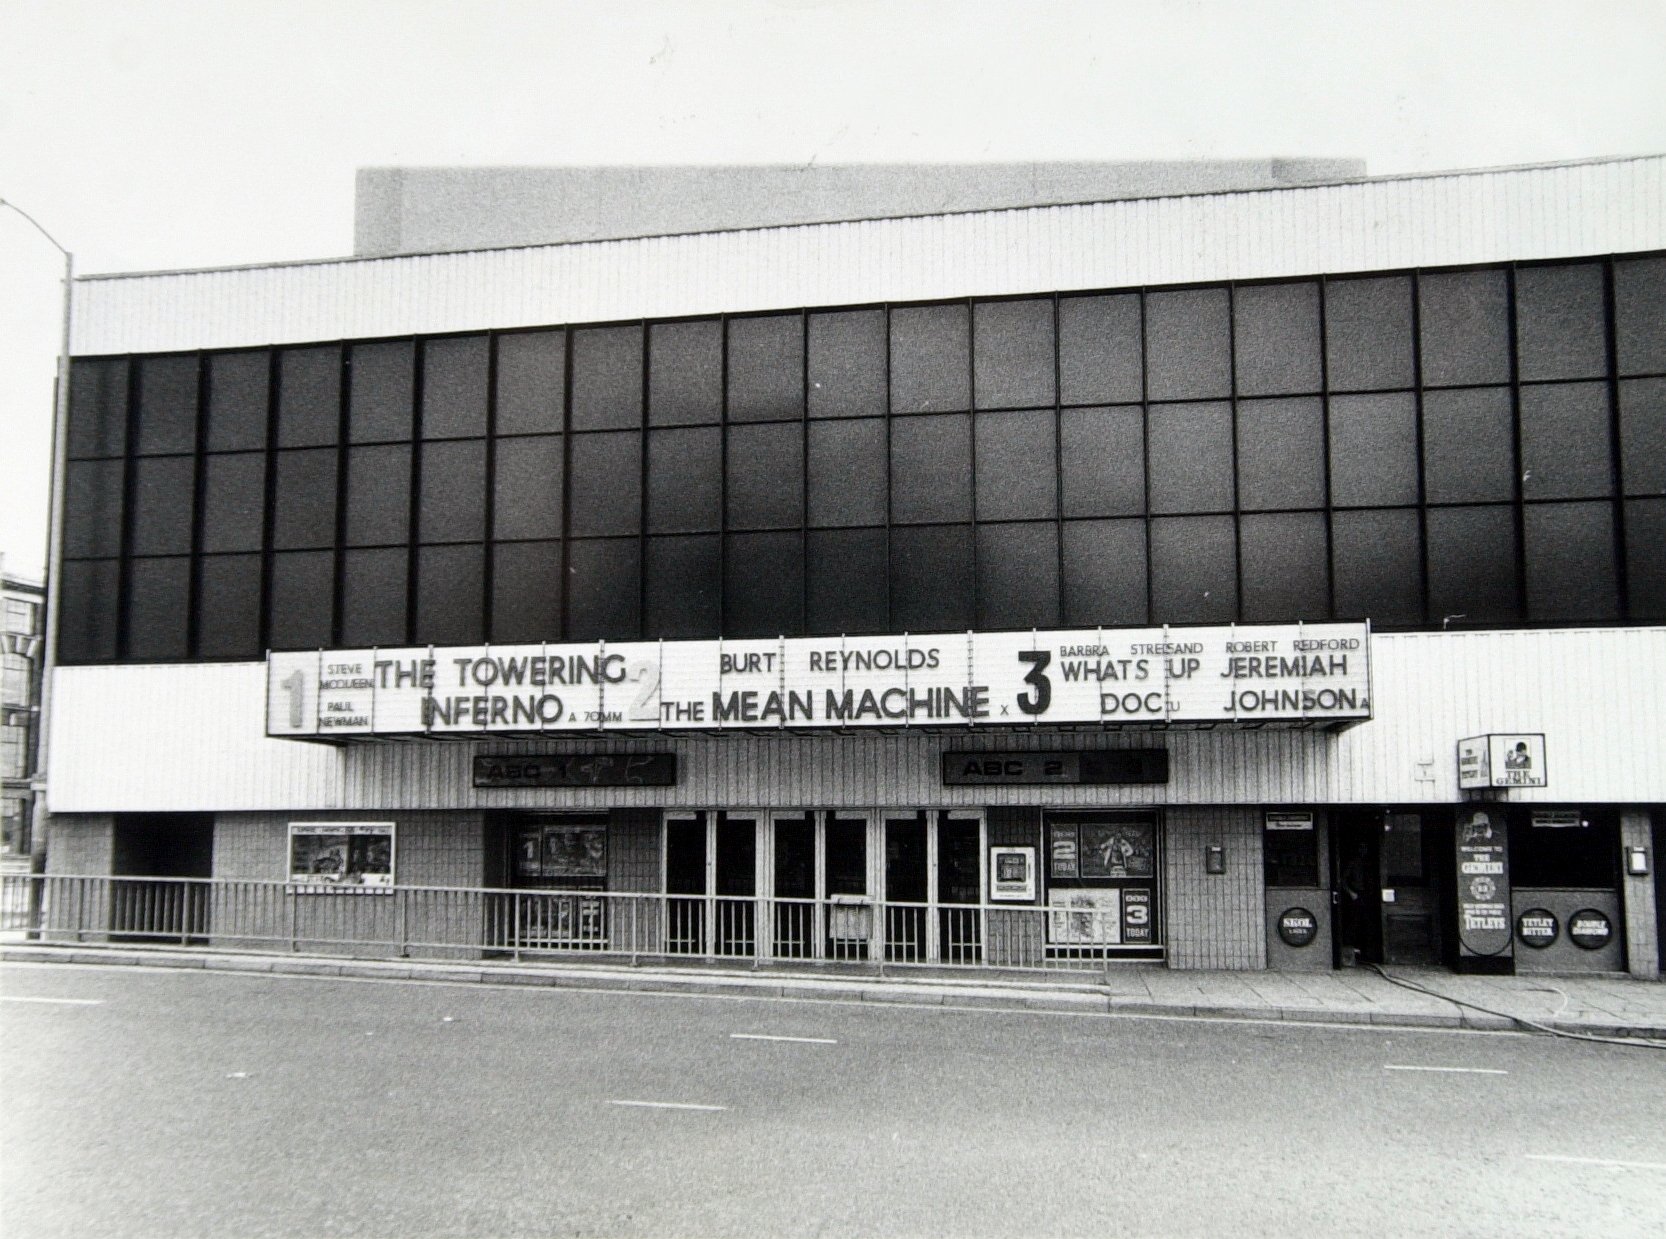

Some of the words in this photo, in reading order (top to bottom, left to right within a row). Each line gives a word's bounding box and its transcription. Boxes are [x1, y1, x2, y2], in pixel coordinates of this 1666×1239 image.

[1060, 644, 1110, 657] BARBRA
[1130, 642, 1204, 656] STREISAND
[1225, 640, 1278, 654] ROBERT
[1293, 637, 1360, 652] REDFORD
[327, 664, 362, 675] STEVE
[375, 659, 436, 689] THE
[453, 653, 626, 688] TOWERING
[720, 652, 777, 674] BURT
[809, 648, 940, 672] REYNOLDS
[1060, 658, 1149, 682] WHATS
[1167, 657, 1201, 679] UP
[1220, 654, 1348, 678] JEREMIAH
[628, 661, 661, 722] 2
[1016, 650, 1052, 716] 3
[281, 669, 305, 729] 1
[327, 702, 353, 712] PAUL
[661, 701, 705, 722] THE
[712, 689, 813, 721] MEAN
[825, 685, 990, 720] MACHINE
[1100, 691, 1163, 714] DOC
[1223, 688, 1358, 713] JOHNSON
[420, 694, 564, 726] INFERNO
[568, 712, 577, 722] A
[583, 710, 623, 723] 70MM
[963, 760, 1024, 776] ABC
[1043, 760, 1064, 776] 2
[1506, 770, 1531, 779] THE
[1495, 777, 1541, 785] GEMINI
[1053, 840, 1076, 860] 2
[1126, 905, 1148, 925] 3
[1283, 917, 1313, 928] SKOL
[1521, 918, 1554, 927] TETLEY
[1126, 928, 1150, 938] TODAY
